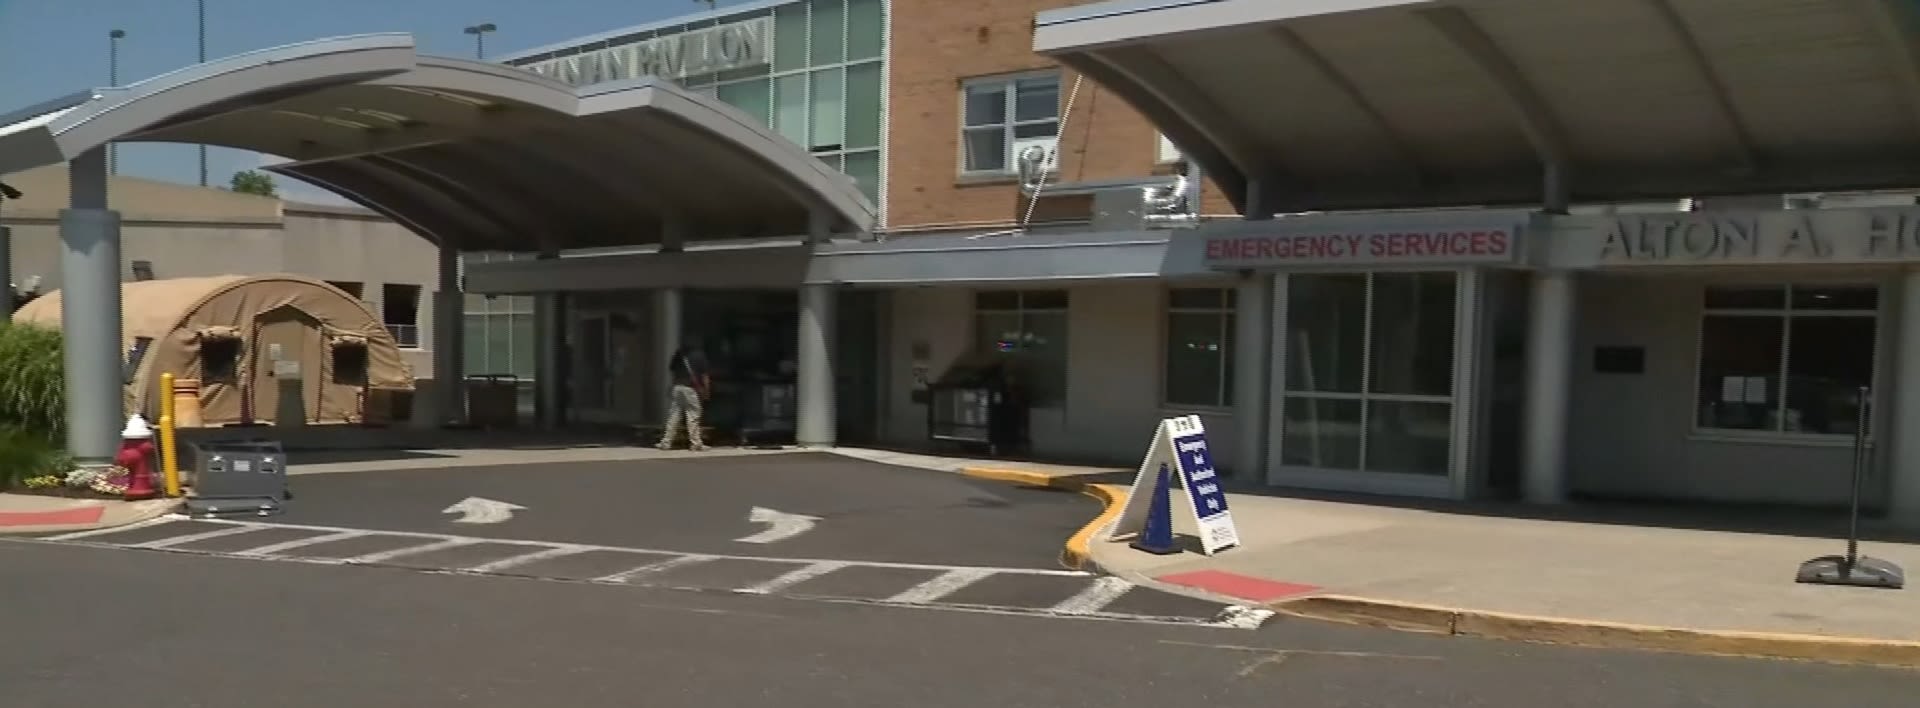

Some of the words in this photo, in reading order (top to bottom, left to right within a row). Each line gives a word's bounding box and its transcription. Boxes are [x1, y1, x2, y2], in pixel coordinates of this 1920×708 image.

[1205, 234, 1361, 260] EMERGENCY
[1369, 230, 1507, 257] SERVICES
[1600, 213, 1760, 260] ALTON
